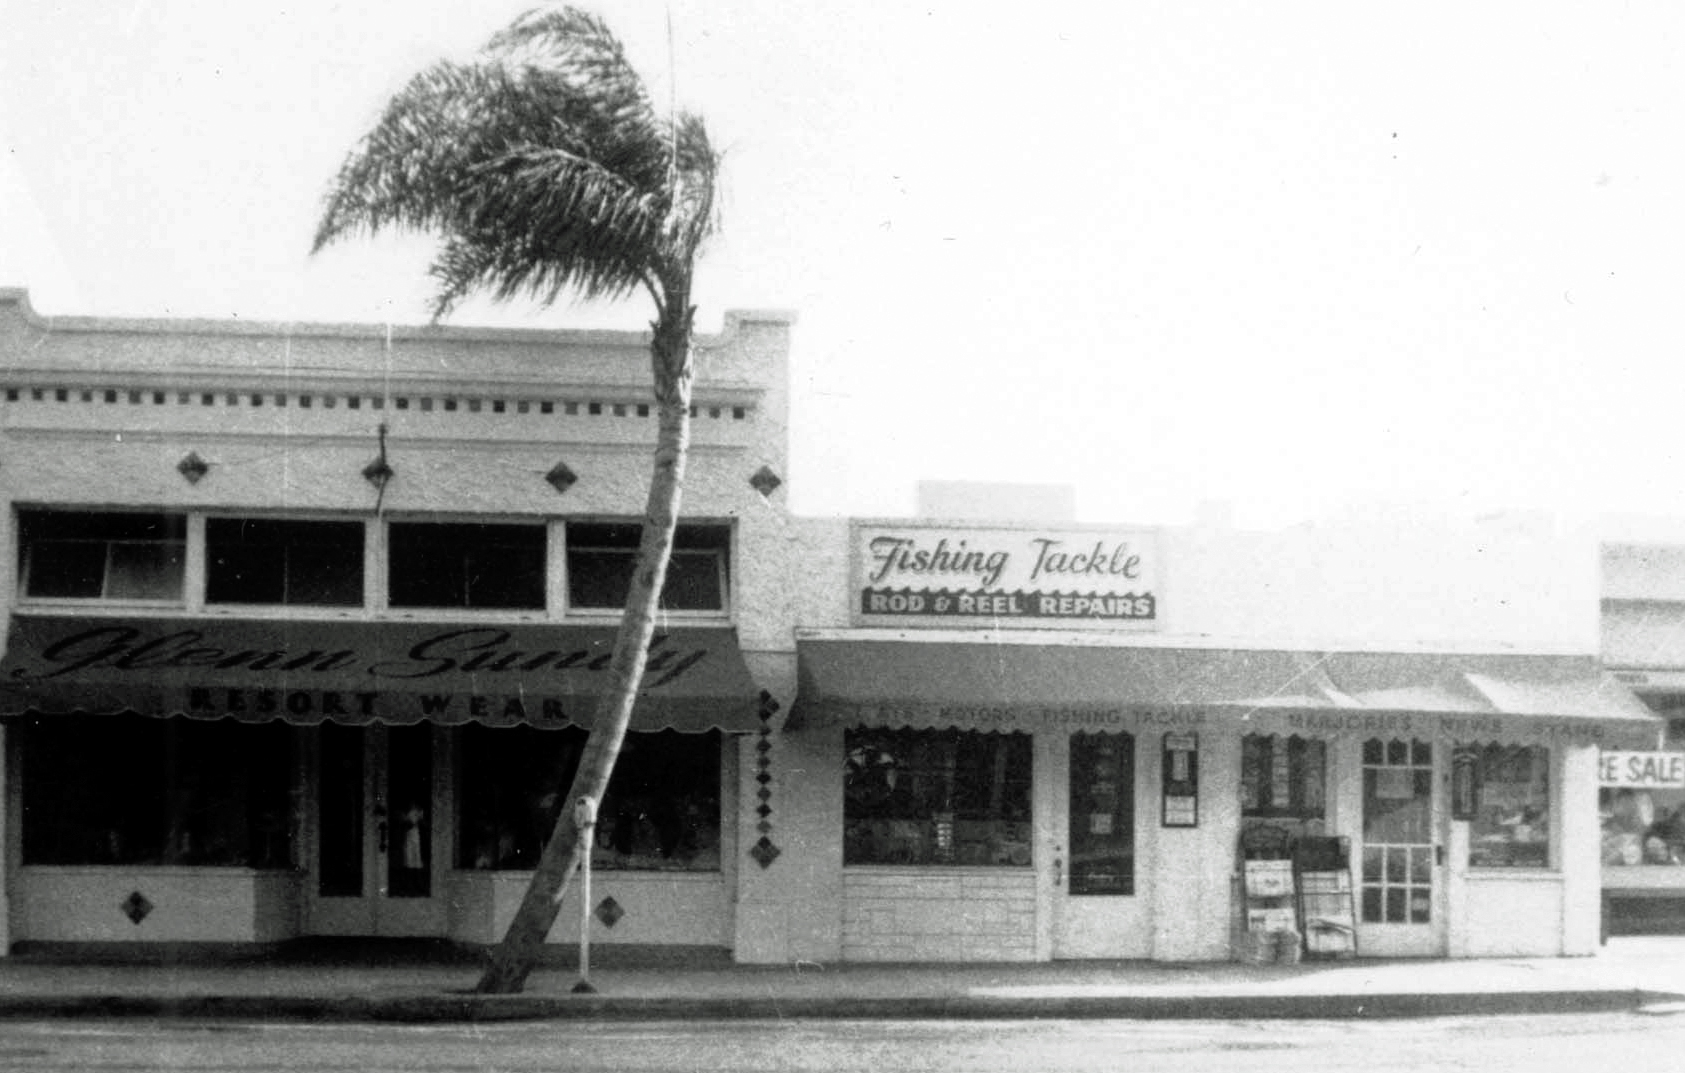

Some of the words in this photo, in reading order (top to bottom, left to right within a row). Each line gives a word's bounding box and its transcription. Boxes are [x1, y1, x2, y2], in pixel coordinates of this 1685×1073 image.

[868, 535, 1010, 586] Fishing
[1030, 537, 1141, 580] Tackle
[869, 593, 926, 613] ROD
[957, 594, 1024, 614] REEL
[1037, 596, 1152, 617] REPAIRS
[10, 625, 358, 680] Glenn
[189, 687, 380, 716] RESORT
[421, 694, 568, 721] WEAR
[939, 707, 1016, 723] MOTORS
[1041, 708, 1121, 724] FISHING
[1132, 709, 1208, 725] TACKLE
[1626, 755, 1683, 782] SALE
